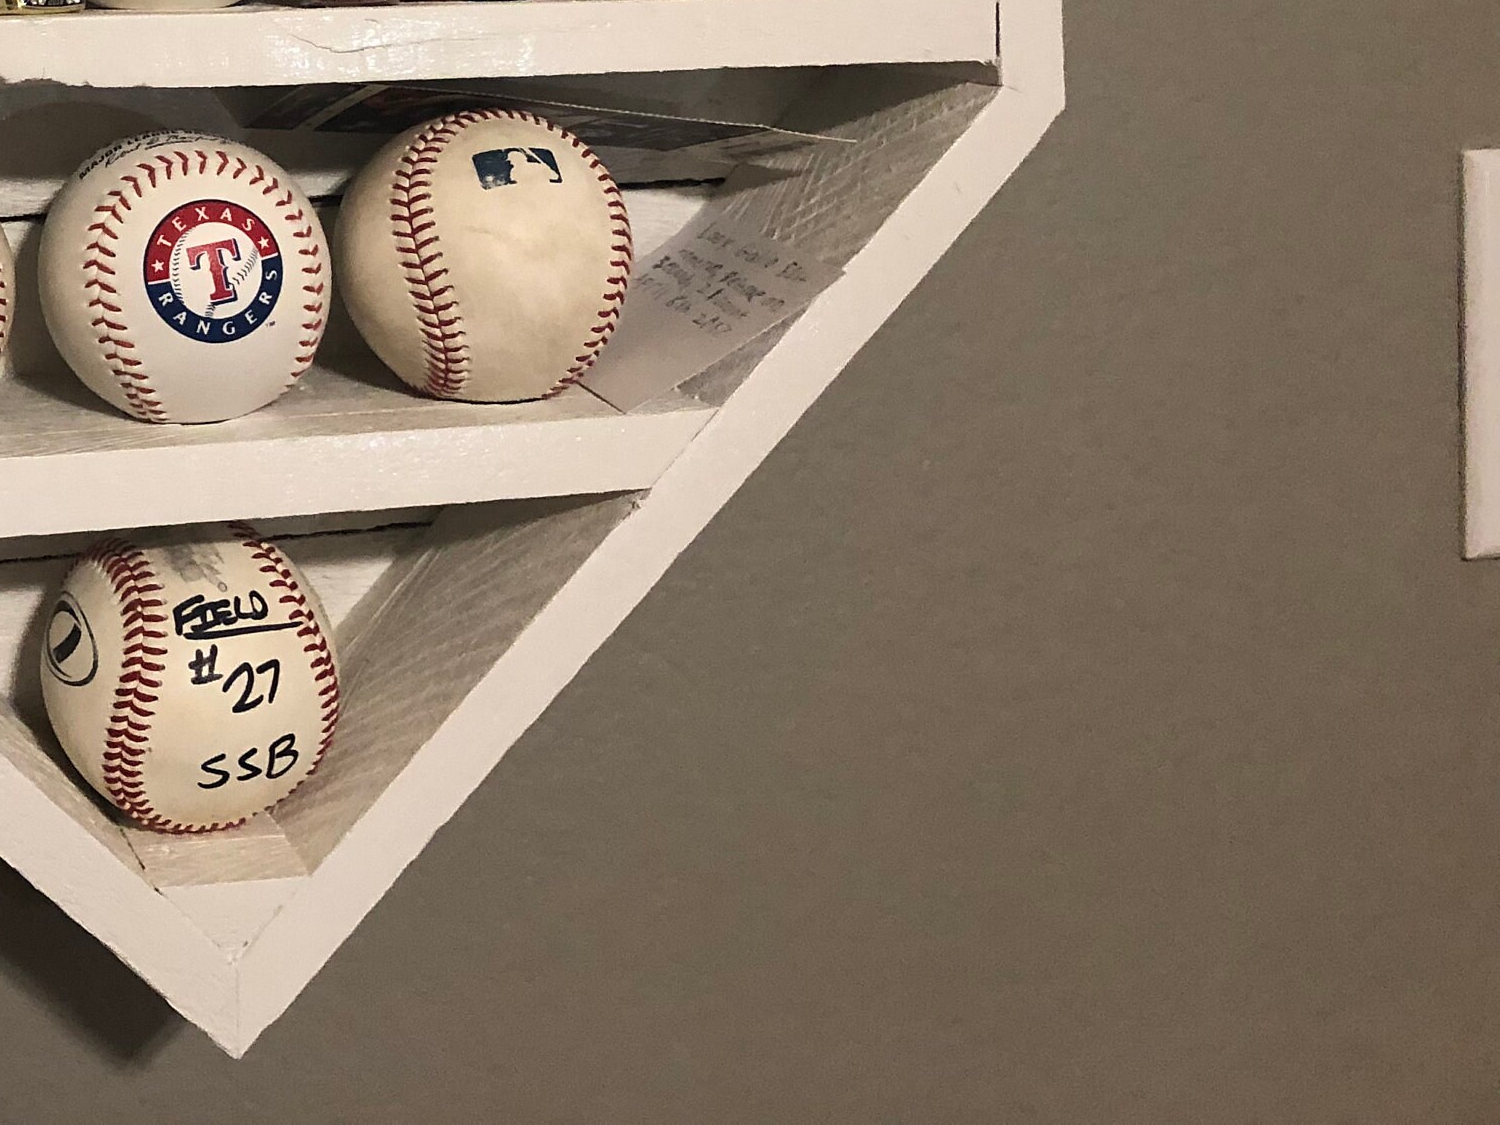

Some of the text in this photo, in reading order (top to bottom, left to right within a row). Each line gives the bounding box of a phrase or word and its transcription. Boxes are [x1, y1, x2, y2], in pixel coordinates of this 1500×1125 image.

[156, 206, 256, 248] TEXAS
[158, 269, 278, 335] RANGERS
[185, 237, 242, 306] T
[197, 733, 299, 789] SSB
